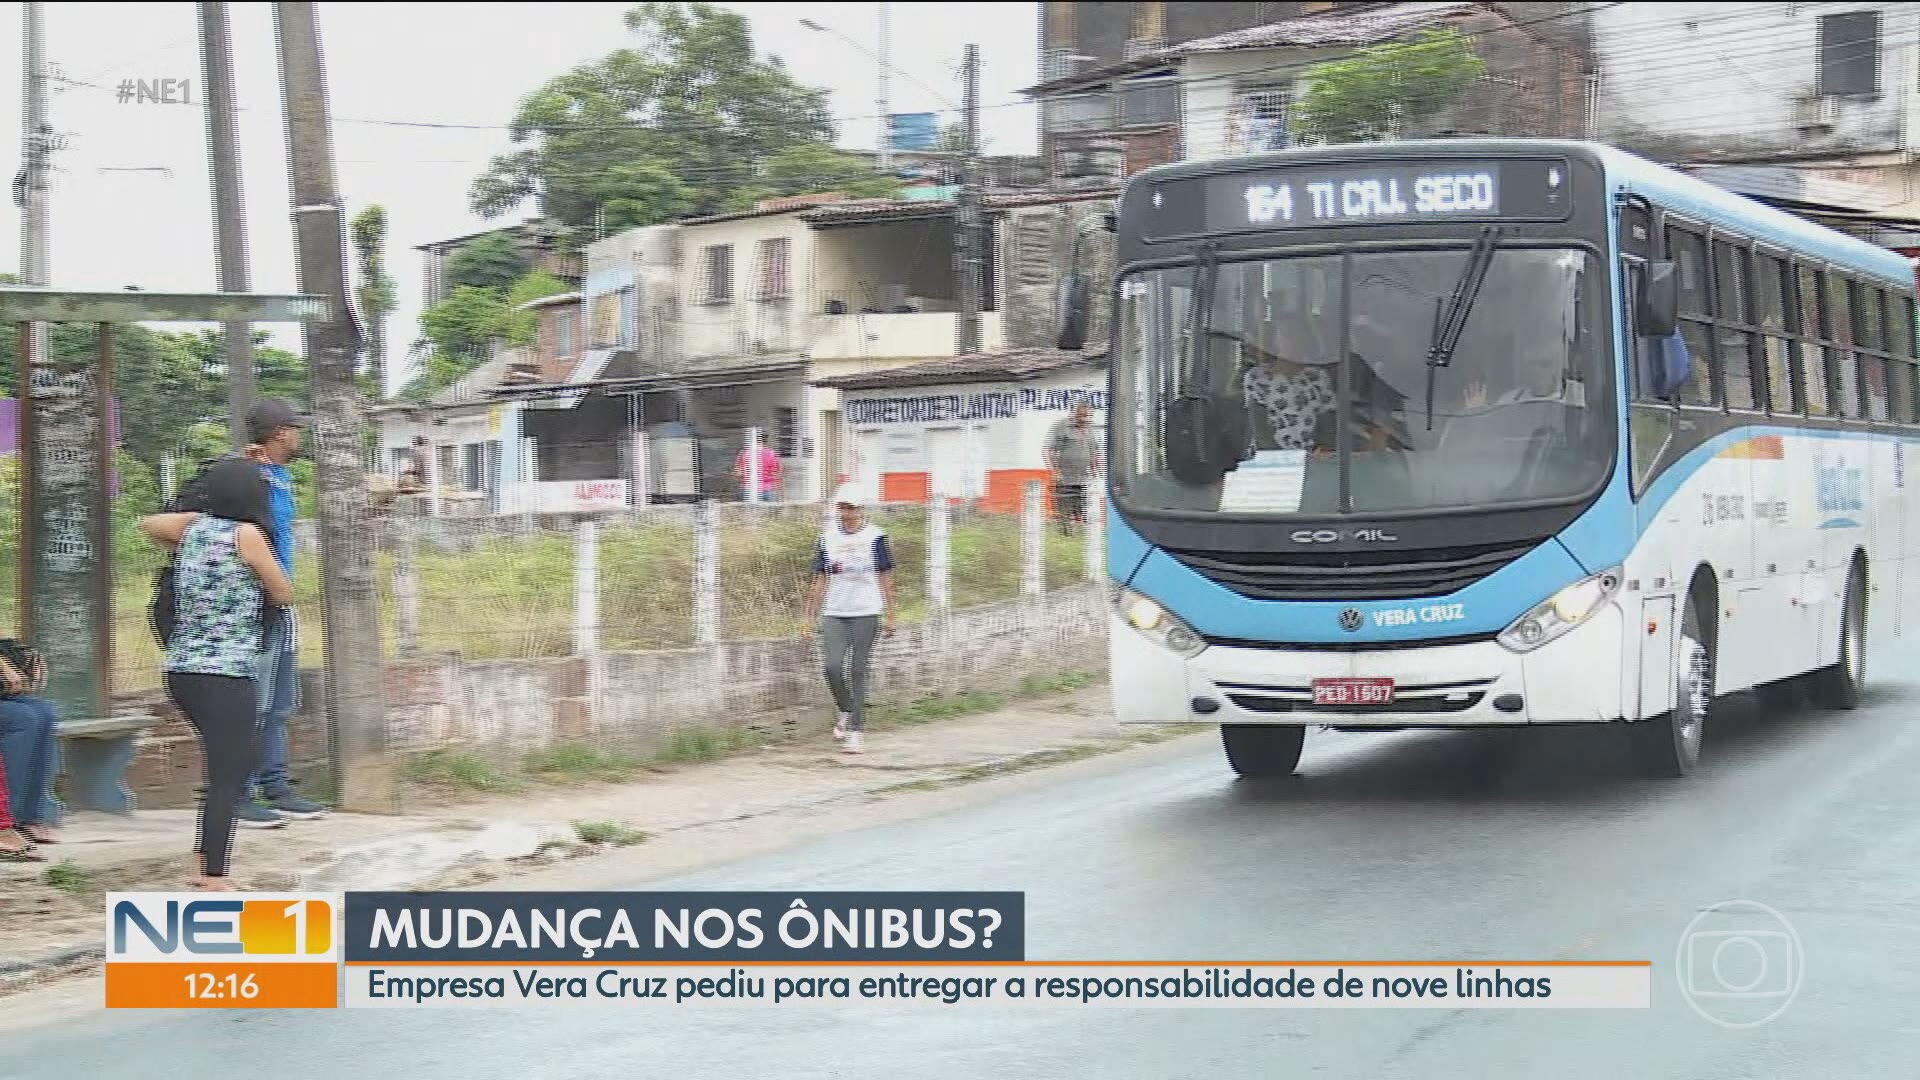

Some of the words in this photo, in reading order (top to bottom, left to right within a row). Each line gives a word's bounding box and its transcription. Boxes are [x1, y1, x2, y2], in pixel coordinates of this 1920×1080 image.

[1243, 183, 1292, 221] 164
[1307, 182, 1335, 218] TI
[1413, 174, 1494, 212] SECO
[847, 395, 926, 425] CORRETOR
[923, 395, 945, 422] DE
[1290, 529, 1398, 542] COMIL
[1373, 609, 1416, 627] VERA
[1420, 604, 1465, 624] CRUZ
